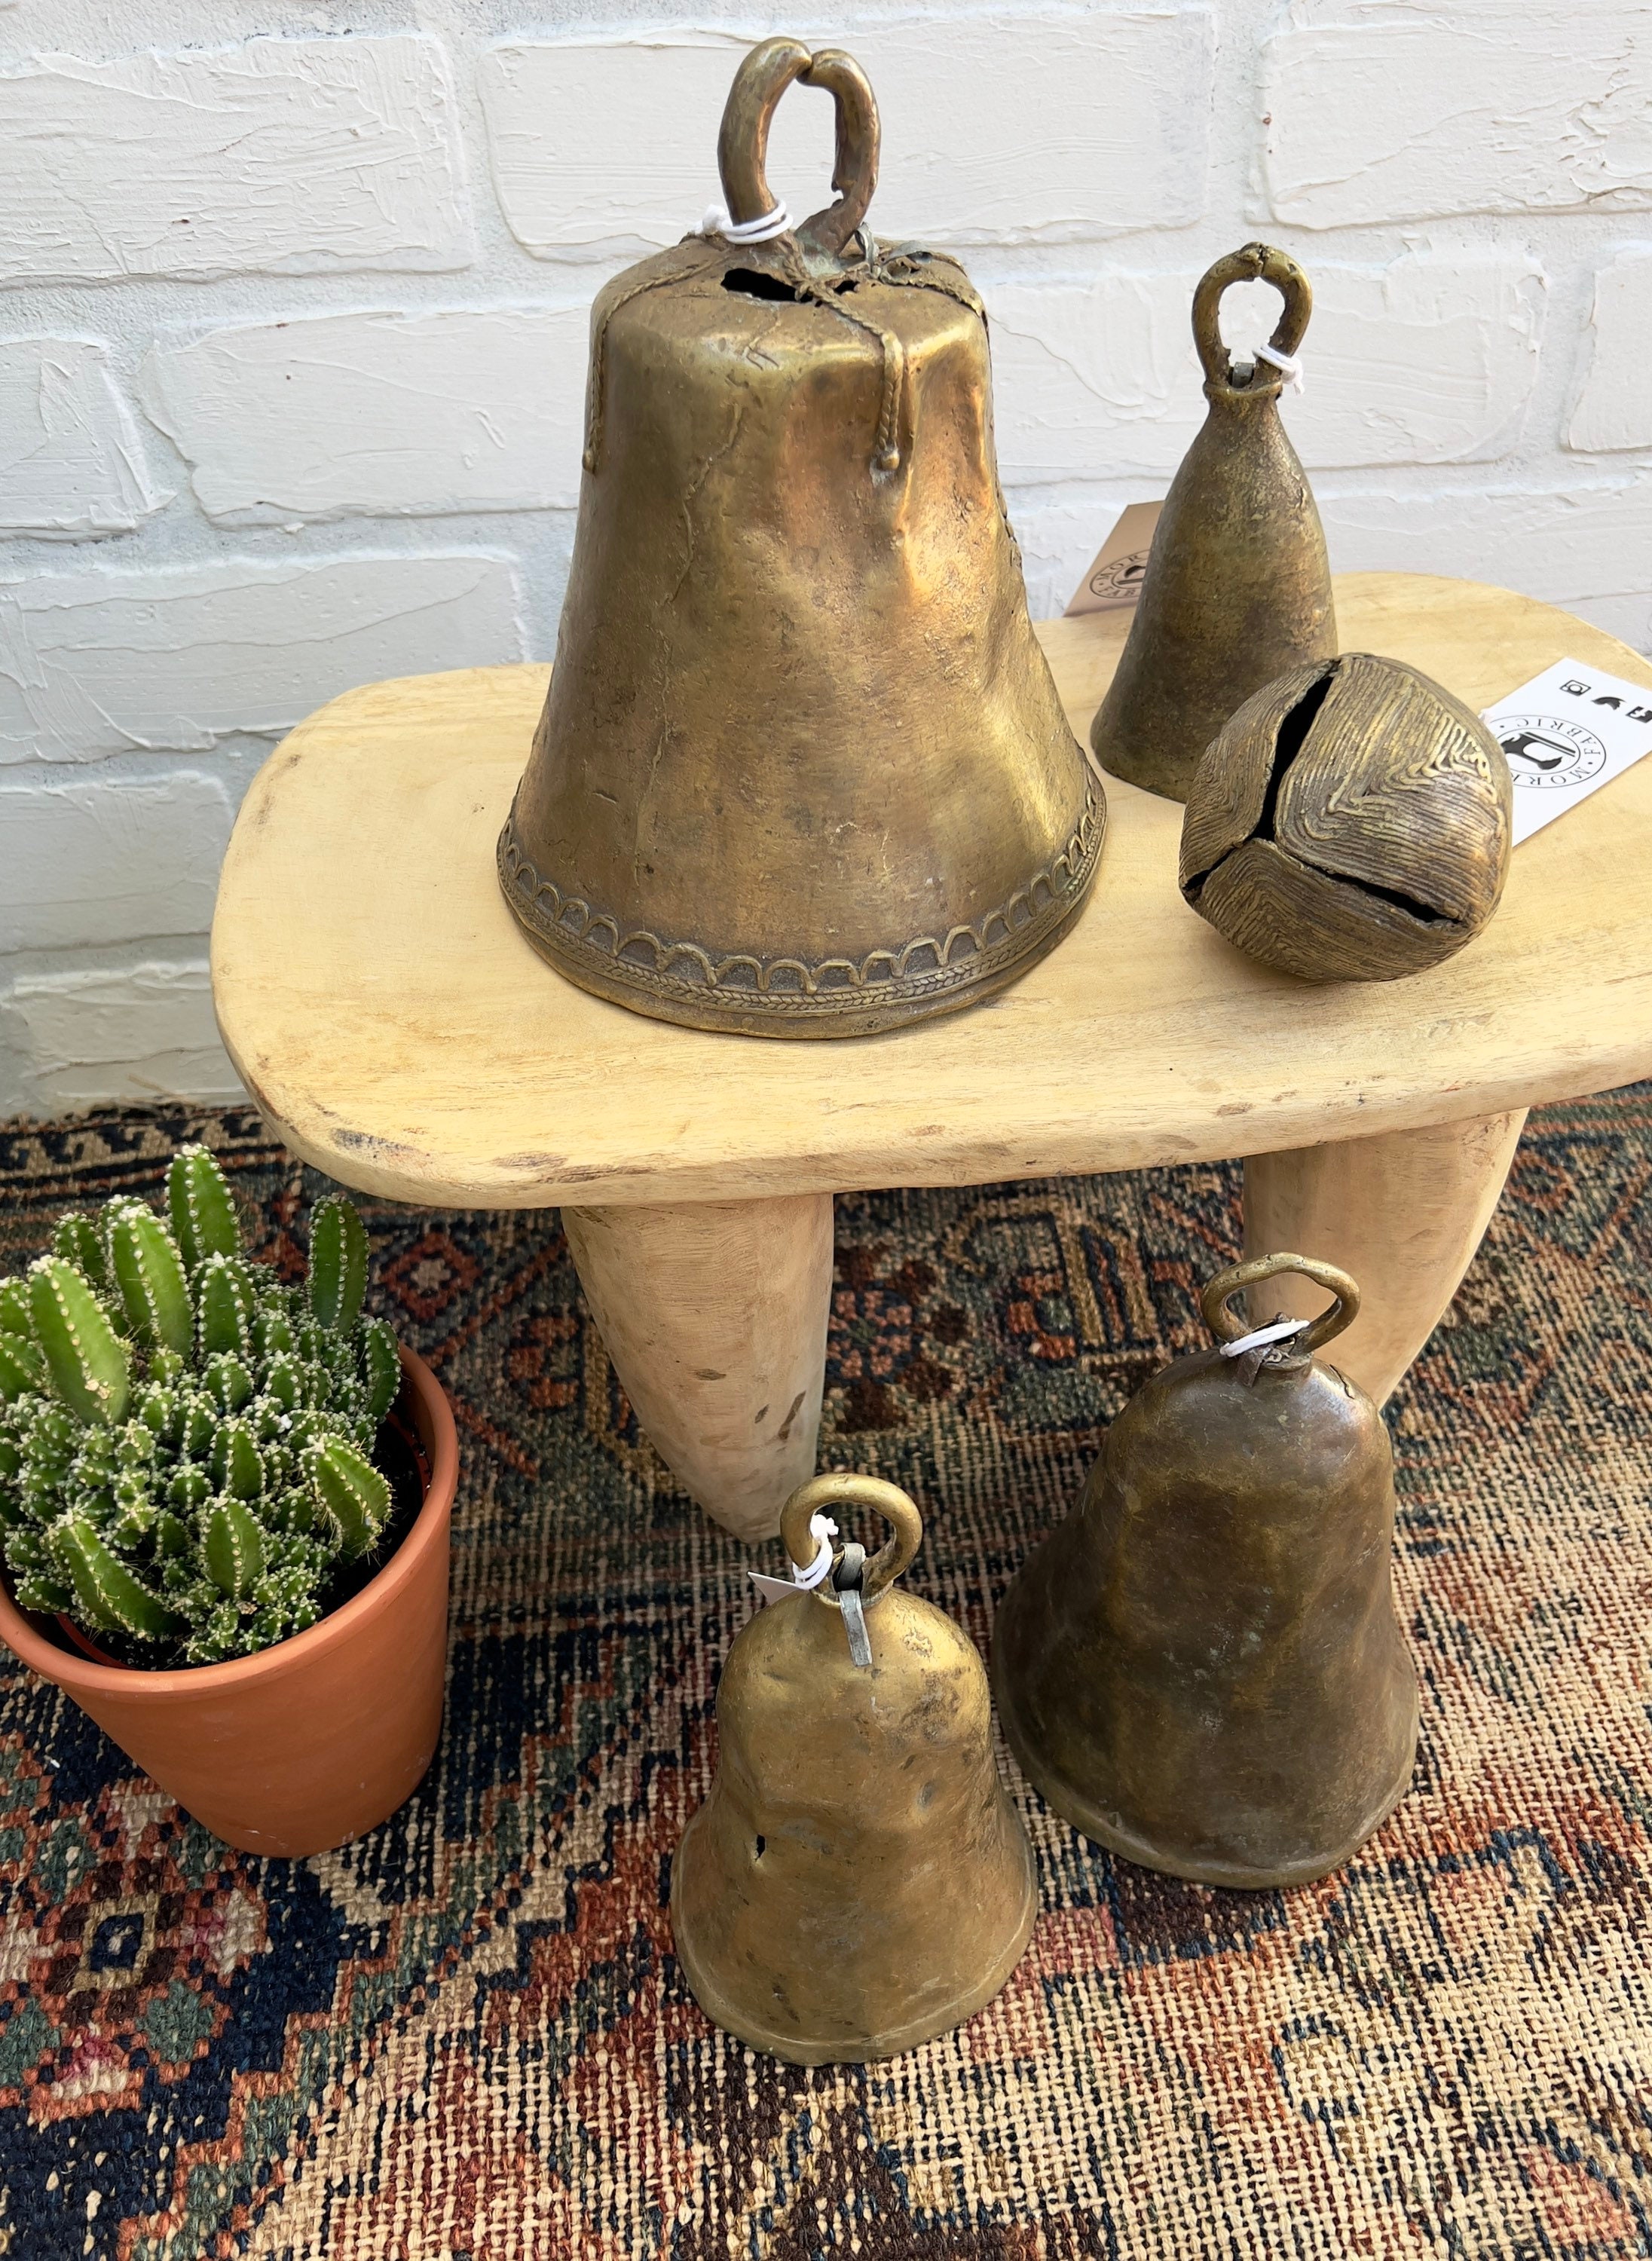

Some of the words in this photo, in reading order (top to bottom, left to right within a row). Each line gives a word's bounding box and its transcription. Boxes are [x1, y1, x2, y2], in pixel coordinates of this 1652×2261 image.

[1096, 555, 1146, 580] MOR
[1098, 586, 1136, 596] FAB
[1516, 718, 1601, 755] FABRIC
